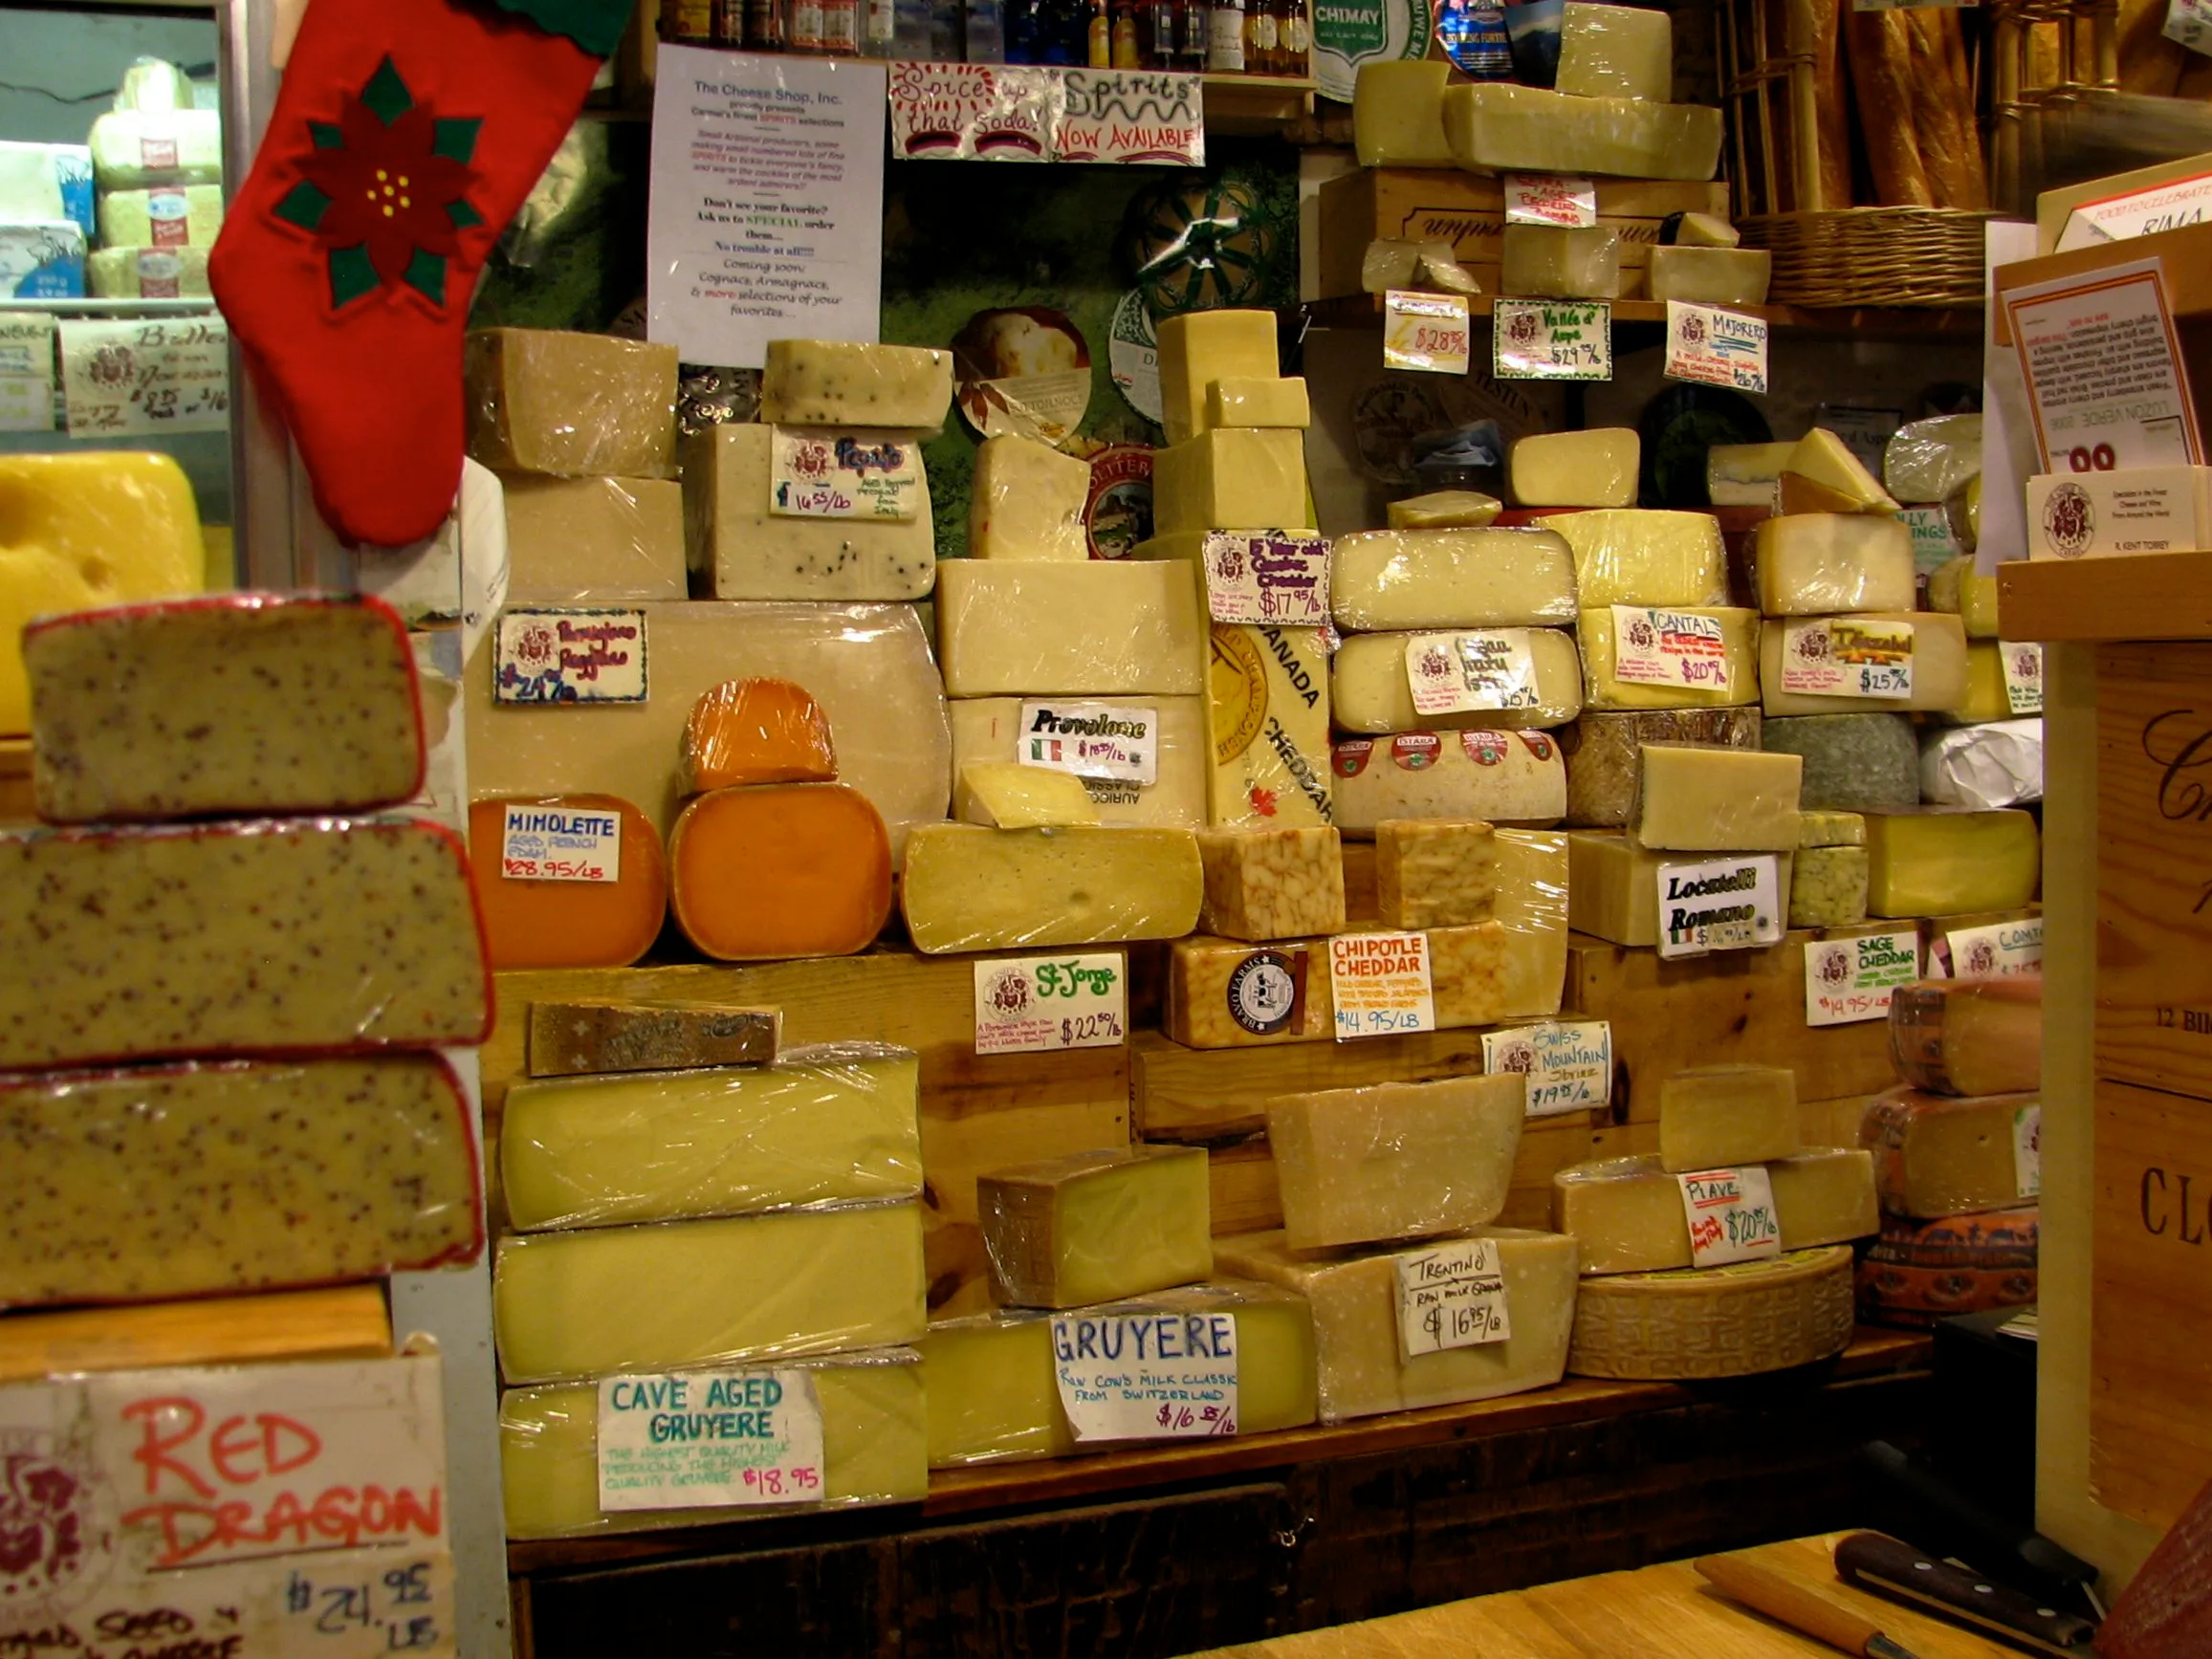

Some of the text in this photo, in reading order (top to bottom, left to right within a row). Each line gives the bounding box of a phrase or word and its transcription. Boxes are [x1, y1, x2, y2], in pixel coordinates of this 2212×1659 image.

[1315, 6, 1379, 26] CHIMAY
[695, 79, 843, 105] The Cheese Shop, Inc.
[895, 66, 985, 101] Spice
[1063, 69, 1190, 119] Spirits
[799, 117, 844, 127] selections
[908, 105, 1040, 135] that soda!
[1056, 119, 1101, 151] NOW
[698, 210, 836, 230] Ask us to SPECIAL order
[704, 197, 734, 208] Don't
[754, 203, 779, 213] your
[780, 203, 827, 215] favorite?
[715, 240, 785, 255] No trouble at
[724, 259, 771, 274] Coming
[705, 290, 737, 298] more
[737, 289, 796, 304] selections
[798, 294, 812, 305] of
[813, 296, 843, 307] your
[1712, 314, 1768, 342] MAJORERO
[1030, 708, 1148, 740] Provolone
[1666, 865, 1758, 901] Locatelli
[1667, 903, 1756, 932] Romano
[1332, 937, 1422, 959] CHIPOTLE
[1857, 937, 1894, 954] SAGE
[1333, 957, 1422, 977] CHEDDAR
[1858, 950, 1915, 971] CHEDDAR
[1035, 959, 1119, 998] St Jorge
[1542, 1044, 1607, 1073] MOUNTAIN
[1685, 1180, 1741, 1201] PIAVE
[1053, 1314, 1234, 1362] GRUYERE
[1139, 1373, 1177, 1386] MILK
[612, 1377, 784, 1411] CAVE AGED
[1074, 1388, 1225, 1403] FROM SWITZERLAND
[649, 1409, 775, 1444] GRUYERE
[120, 1395, 323, 1500] RED
[742, 1468, 820, 1496] $18.95
[119, 1485, 442, 1567] DRAGON
